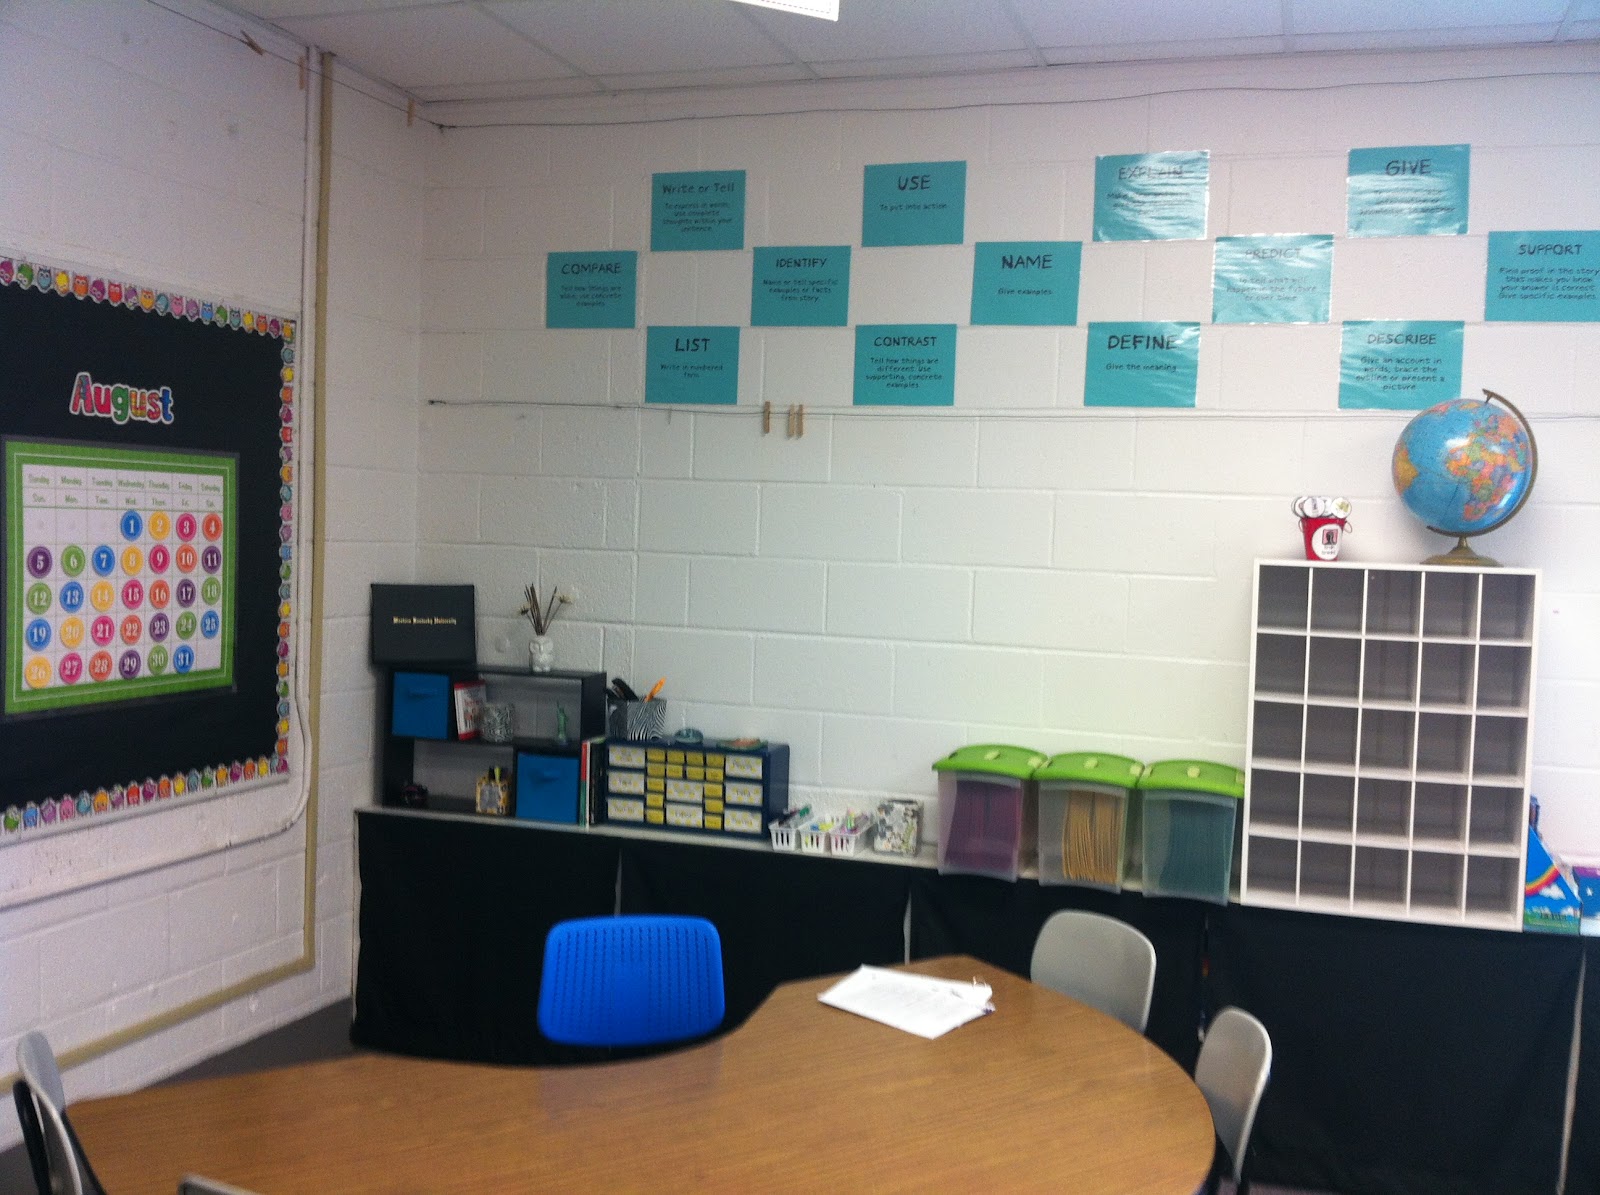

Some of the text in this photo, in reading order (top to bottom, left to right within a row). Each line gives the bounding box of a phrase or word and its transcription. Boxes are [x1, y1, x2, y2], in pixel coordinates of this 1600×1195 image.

[1386, 158, 1432, 176] GIVE
[662, 184, 694, 194] Write
[714, 182, 734, 192] Tell
[897, 174, 931, 191] USE
[1245, 248, 1301, 260] PREDICT
[1519, 244, 1582, 255] SUPPORT
[561, 262, 622, 275] COMPARE
[775, 257, 828, 268] IDENTIFY
[1001, 254, 1053, 269] NAME
[675, 337, 711, 352] LIST
[874, 336, 937, 347] CONTRAST
[1108, 334, 1178, 350] DEFINE
[1367, 334, 1437, 345] DESCRIBE
[1361, 356, 1380, 364] Give
[1143, 363, 1177, 372] meaning
[70, 372, 174, 424] August
[181, 552, 193, 566] 10
[206, 553, 217, 566] 11
[34, 591, 46, 605] 12
[66, 590, 79, 605] 13
[128, 587, 139, 602] 15
[155, 588, 166, 602] 16
[182, 586, 192, 600] 17
[207, 585, 217, 598] 18
[33, 618, 216, 642] 19 20 21 22 23 24 25
[32, 652, 190, 679] 26 27 28 29 30 31
